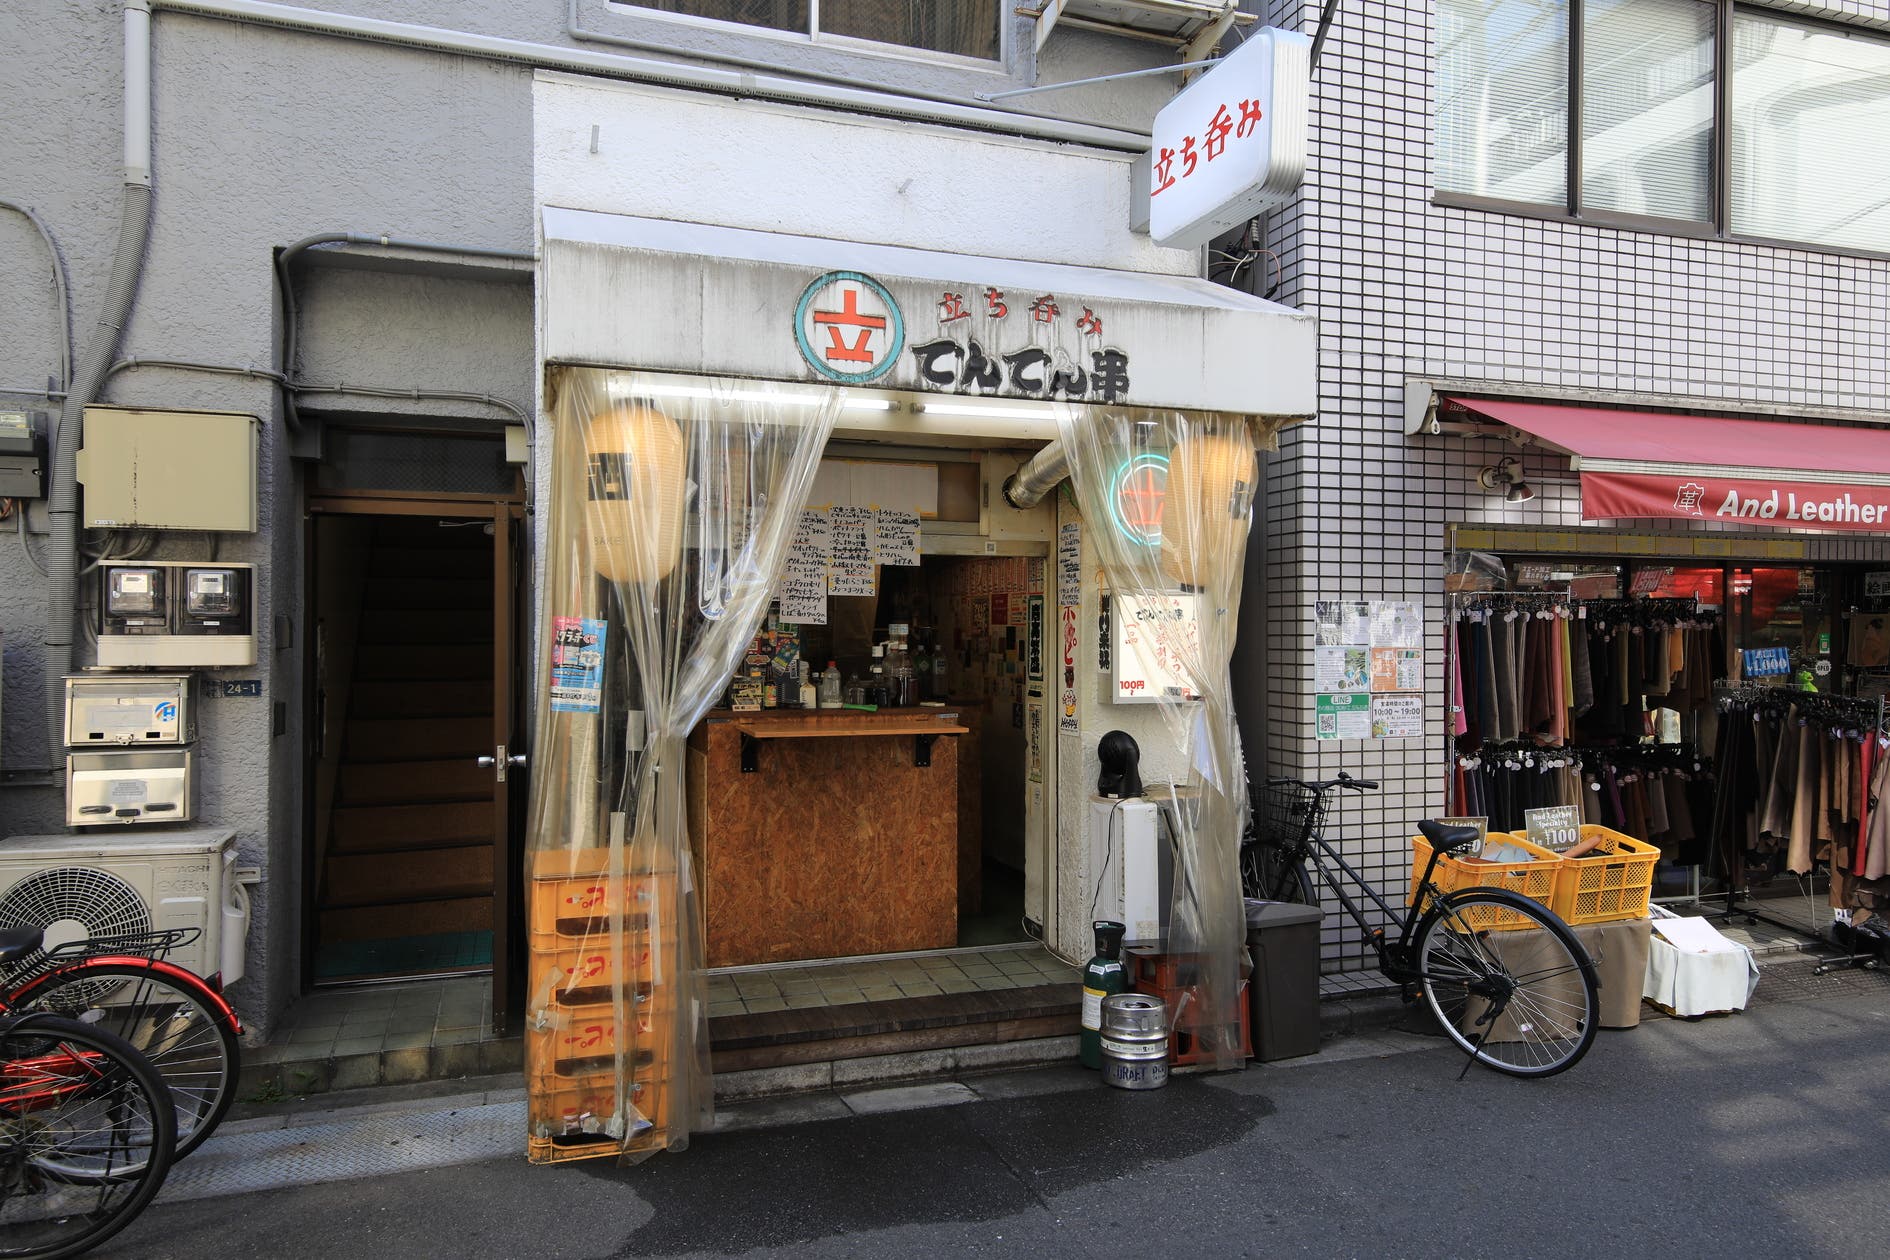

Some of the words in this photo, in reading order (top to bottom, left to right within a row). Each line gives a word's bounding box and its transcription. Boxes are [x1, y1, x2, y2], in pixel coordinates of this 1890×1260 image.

[1151, 99, 1262, 197] 立ち呑み
[814, 289, 886, 362] 立
[938, 287, 1102, 335] 立ち呑み
[911, 338, 1130, 402] てんてん串
[1716, 490, 1779, 519] And
[1786, 493, 1888, 524] Leather
[227, 683, 256, 694] 24-1
[1120, 680, 1145, 690] 100円
[1333, 696, 1350, 704] LINE
